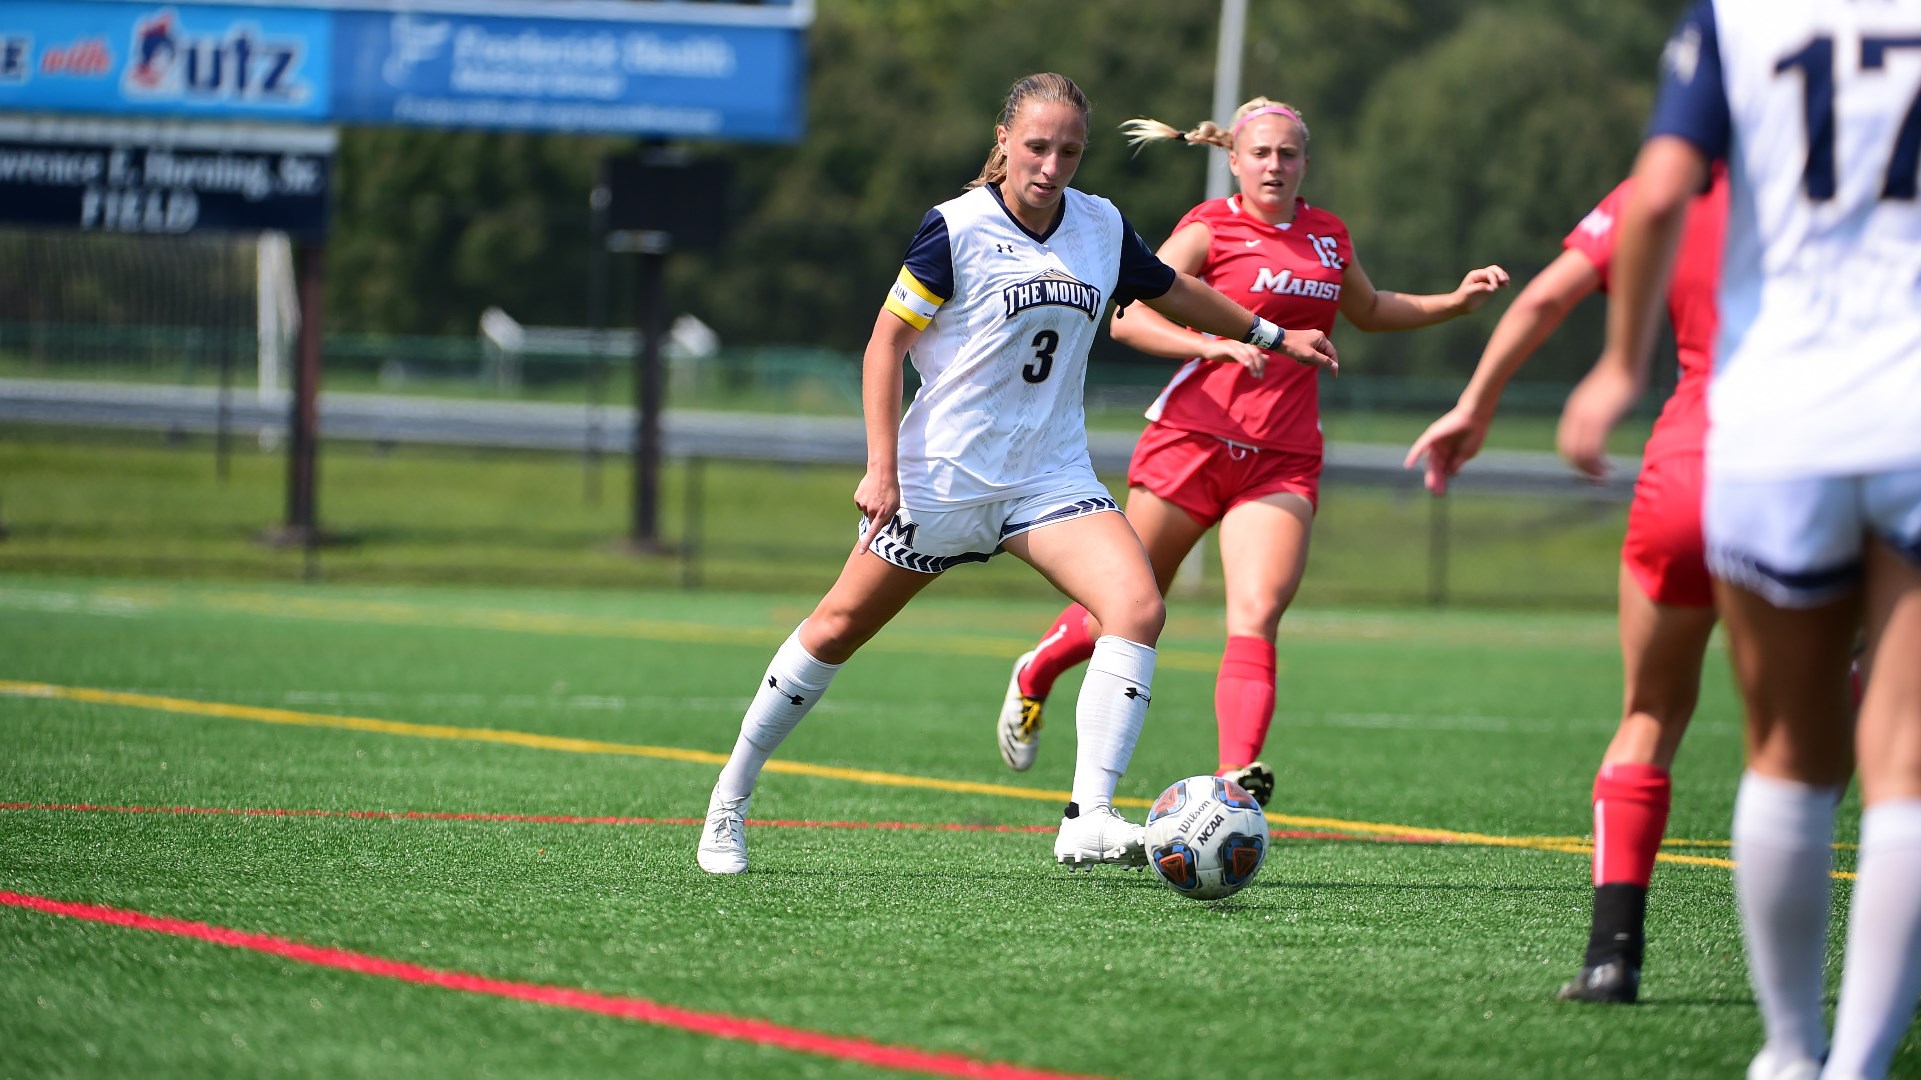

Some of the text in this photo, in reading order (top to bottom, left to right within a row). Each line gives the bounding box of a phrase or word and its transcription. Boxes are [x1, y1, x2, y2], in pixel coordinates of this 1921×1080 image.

[42, 40, 110, 74] with
[1773, 36, 1921, 200] 17
[81, 188, 200, 232] FIELD
[894, 281, 907, 301] AIN
[1005, 281, 1100, 317] THE MOUNT
[1022, 329, 1060, 384] 3
[1178, 799, 1211, 834] Wilson
[1197, 814, 1225, 847] NCAA
